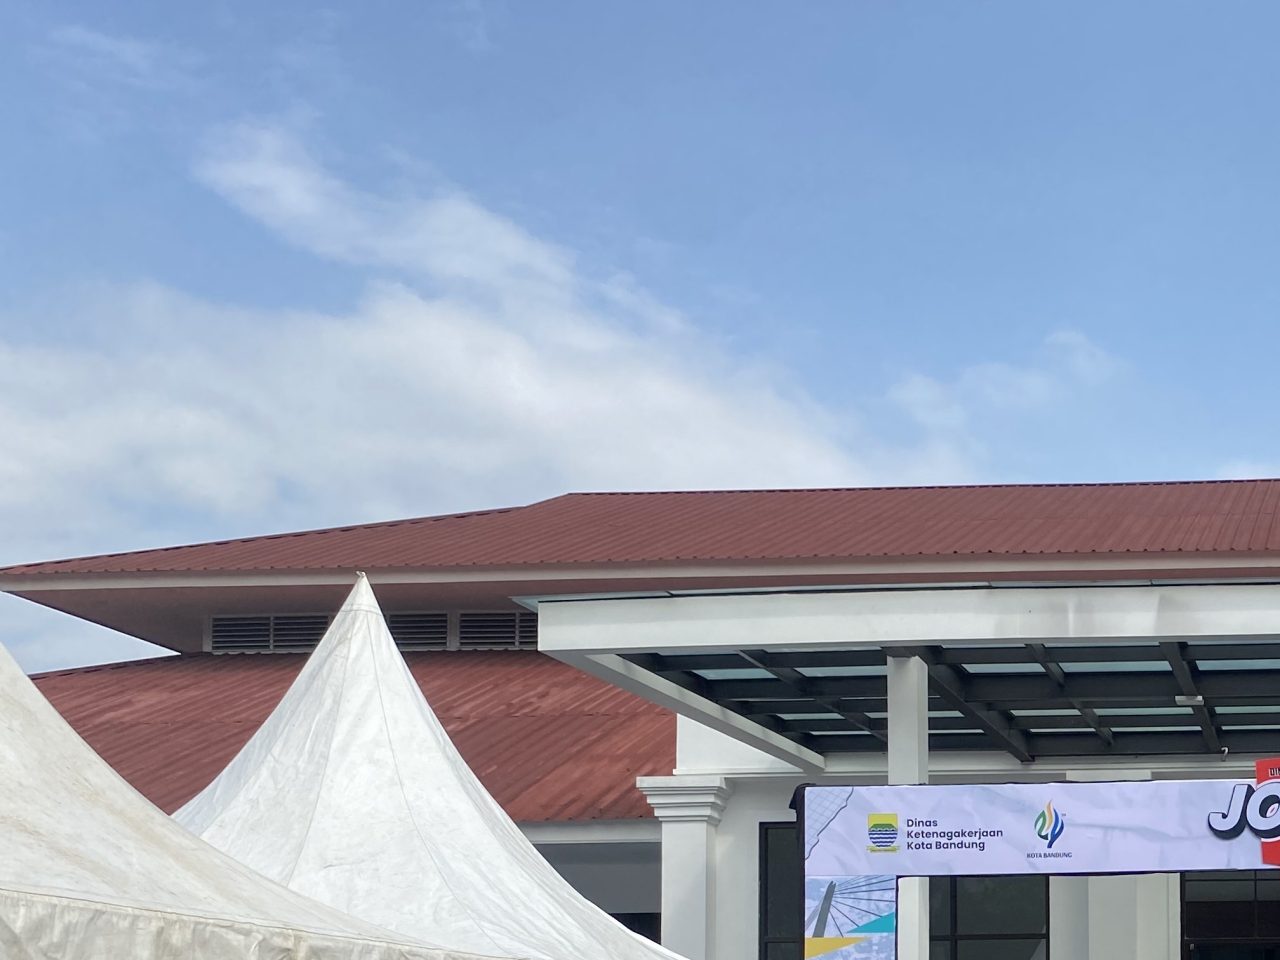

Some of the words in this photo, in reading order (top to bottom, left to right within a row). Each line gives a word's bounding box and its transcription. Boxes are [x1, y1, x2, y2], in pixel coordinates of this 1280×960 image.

[906, 818, 938, 828] Dinas
[906, 828, 1003, 840] Ketenagakerjaan
[907, 841, 932, 850] Kota
[935, 841, 985, 851] Bandung
